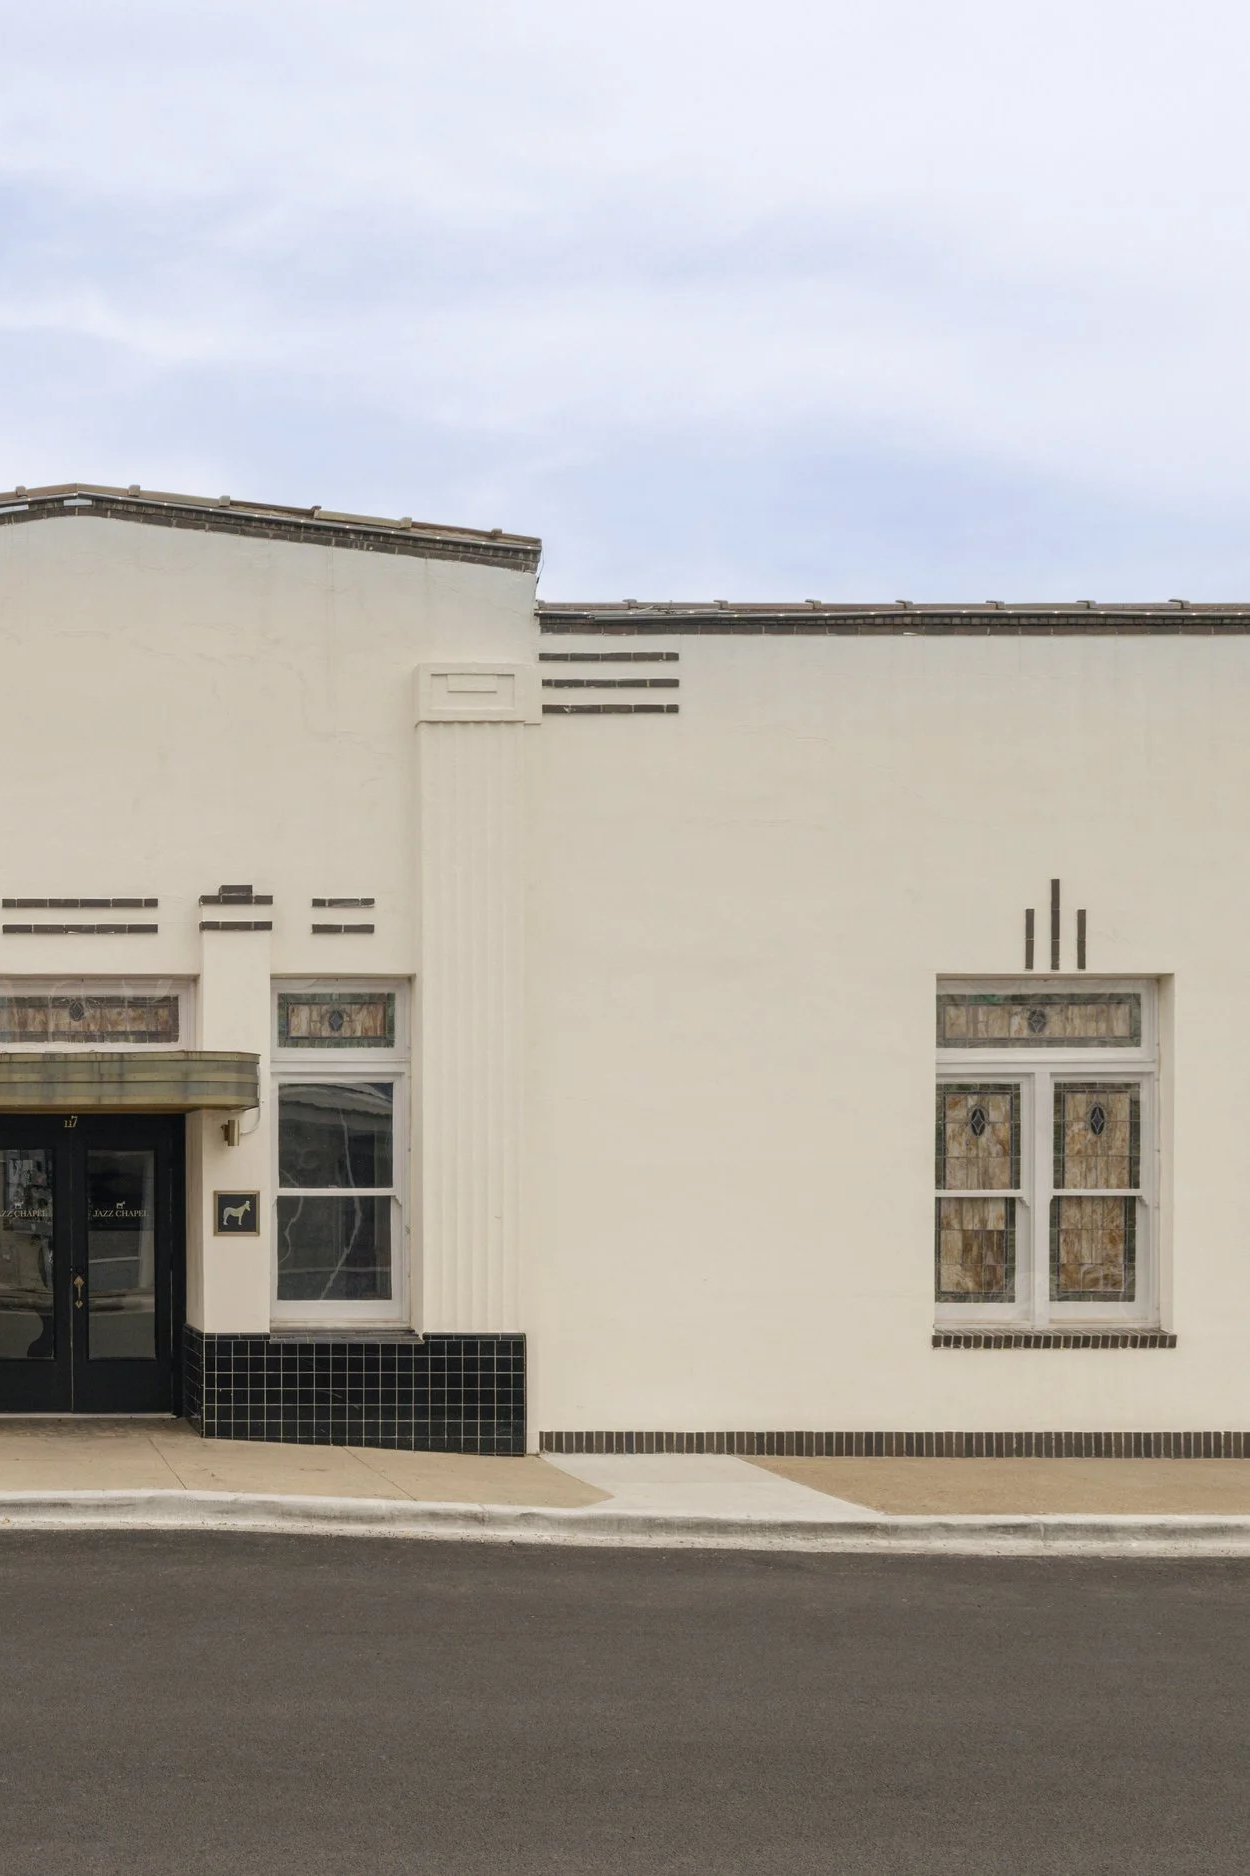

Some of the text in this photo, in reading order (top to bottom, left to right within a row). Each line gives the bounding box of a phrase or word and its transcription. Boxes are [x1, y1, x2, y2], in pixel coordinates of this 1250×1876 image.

[15, 1209, 48, 1218] CHAPEL
[93, 1209, 149, 1218] JAZZ CHAPEL
